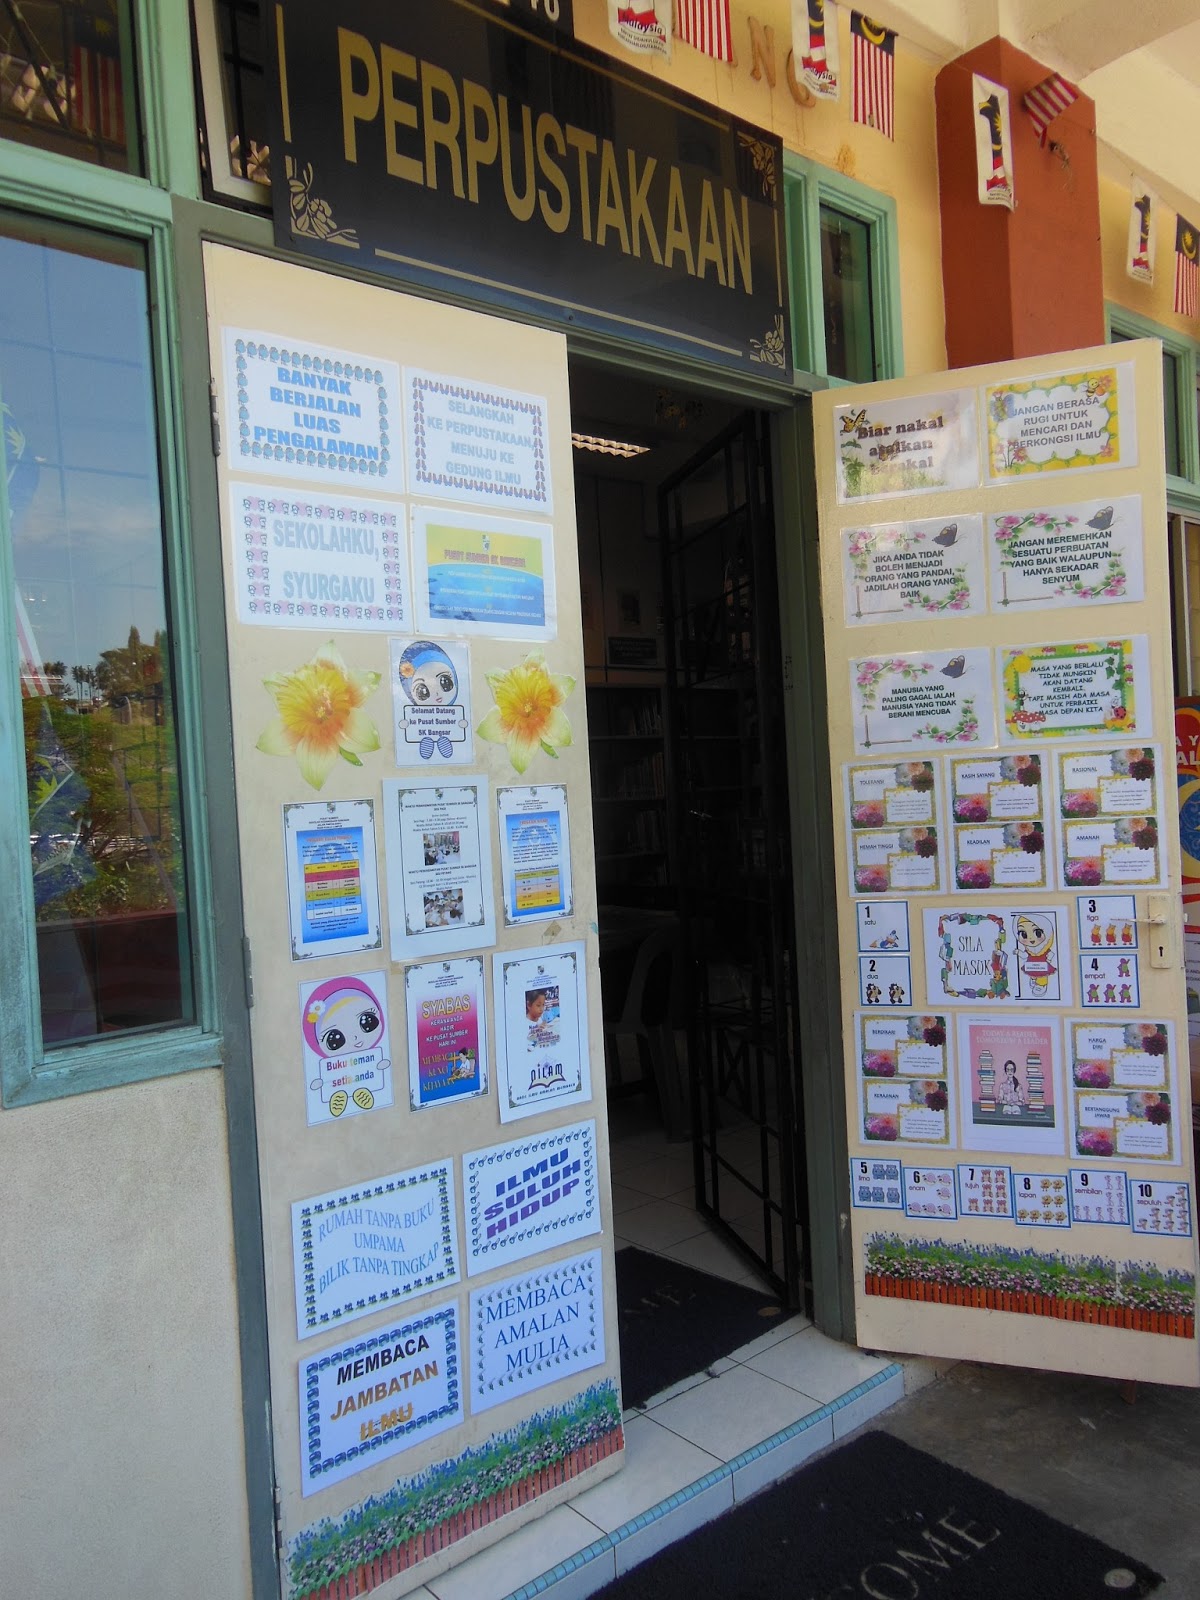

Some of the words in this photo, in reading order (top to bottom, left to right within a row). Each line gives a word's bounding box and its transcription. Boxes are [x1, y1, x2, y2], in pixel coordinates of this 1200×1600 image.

[337, 27, 754, 294] PERPUSTAKAAN
[277, 367, 352, 396] BANYAK
[270, 387, 361, 418] BERJALAN
[1013, 403, 1054, 416] JANGAN
[1057, 396, 1099, 410] BERASA
[448, 400, 514, 424] SELANGKAH
[1024, 416, 1049, 425] RUGI
[1052, 410, 1088, 422] UNTUK
[294, 412, 341, 434] LUAS
[427, 416, 443, 430] KE
[857, 425, 891, 439] Biar
[896, 416, 944, 434] nakal
[1021, 424, 1067, 437] MENCARI
[1071, 421, 1092, 429] DAN
[254, 426, 379, 460] PENGALAMAN
[1014, 435, 1073, 450] BERKONGSI
[1076, 431, 1101, 441] ILMU
[451, 442, 497, 461] MENUJU
[500, 452, 514, 464] KE
[446, 461, 492, 480] GEDUNG
[495, 471, 521, 485] ILMU
[273, 520, 379, 561] SEKOLAHKU,
[1008, 539, 1044, 548] JANGAN
[1046, 531, 1112, 544] MEREMEHKAN
[873, 555, 892, 563] JIKA
[894, 553, 917, 561] ANDA
[919, 550, 944, 558] TIDAK
[1012, 548, 1052, 558] SESUATU
[1055, 542, 1109, 553] PERBUATAN
[876, 563, 904, 572] BOLEH
[905, 560, 943, 569] MENJADI
[1010, 559, 1034, 568] YANG
[1037, 556, 1057, 565] BAIK
[1059, 551, 1111, 562] WALAUPUN
[865, 572, 894, 583] ORANG
[897, 572, 919, 580] YANG
[921, 568, 955, 577] PANDAI,
[1023, 568, 1053, 577] HANYA
[1055, 563, 1098, 573] SEKADAR
[283, 571, 375, 603] SYURGAKU
[864, 583, 899, 592] JADILAH
[901, 580, 931, 589] ORANG
[933, 577, 955, 585] YANG
[1042, 574, 1080, 585] SENYUM
[901, 590, 920, 598] BAIK
[865, 906, 870, 918] 1
[1089, 900, 1096, 913] 3
[959, 936, 983, 952] SILA
[869, 960, 876, 972] 2
[954, 960, 991, 975] MASUK
[1091, 958, 1098, 970] 4
[422, 994, 470, 1019] SYABAS
[326, 1059, 347, 1071] Buku
[350, 1054, 375, 1066] teman
[355, 1070, 374, 1083] anda
[496, 1148, 569, 1197] ILMU
[860, 1162, 868, 1174] 5
[913, 1171, 921, 1183] 6
[969, 1168, 975, 1180] 7
[1024, 1177, 1030, 1190] 8
[1080, 1173, 1088, 1186] 9
[484, 1159, 581, 1221] SULUH
[1138, 1184, 1152, 1197] 10
[486, 1178, 580, 1239] HIDUP
[318, 1208, 363, 1242] RUMAH
[366, 1209, 402, 1229] TANPA
[404, 1198, 435, 1229] BUKU
[354, 1233, 405, 1252] UMPAMA
[319, 1258, 350, 1295] BILIK
[353, 1257, 389, 1275] TANPA
[391, 1242, 439, 1275] TINGKAP
[486, 1275, 586, 1324] MEMBACA
[495, 1302, 579, 1349] AMALAN
[337, 1335, 429, 1386] MEMBACA
[506, 1334, 571, 1372] MULIA
[331, 1360, 439, 1421] JAMBATAN
[359, 1402, 414, 1441] ILMU
[857, 1507, 1001, 1600] OME
